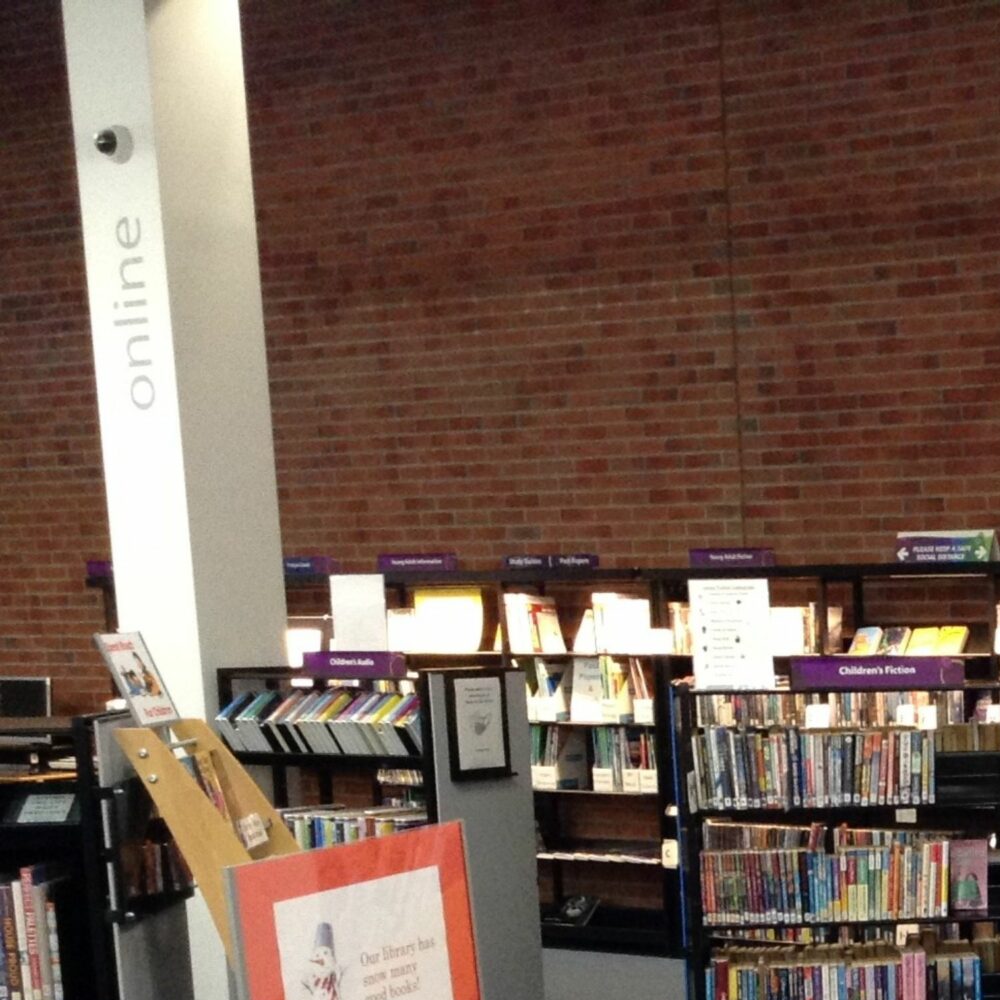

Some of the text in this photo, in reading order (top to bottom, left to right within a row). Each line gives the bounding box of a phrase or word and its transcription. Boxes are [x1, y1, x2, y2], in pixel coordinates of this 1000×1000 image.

[114, 216, 155, 410] online
[329, 657, 357, 666] Children's
[838, 665, 916, 676] Children's Fiction
[360, 936, 436, 966] Our library has
[8, 953, 19, 987] PROUD
[363, 962, 417, 987] snow many
[388, 976, 420, 998] books!
